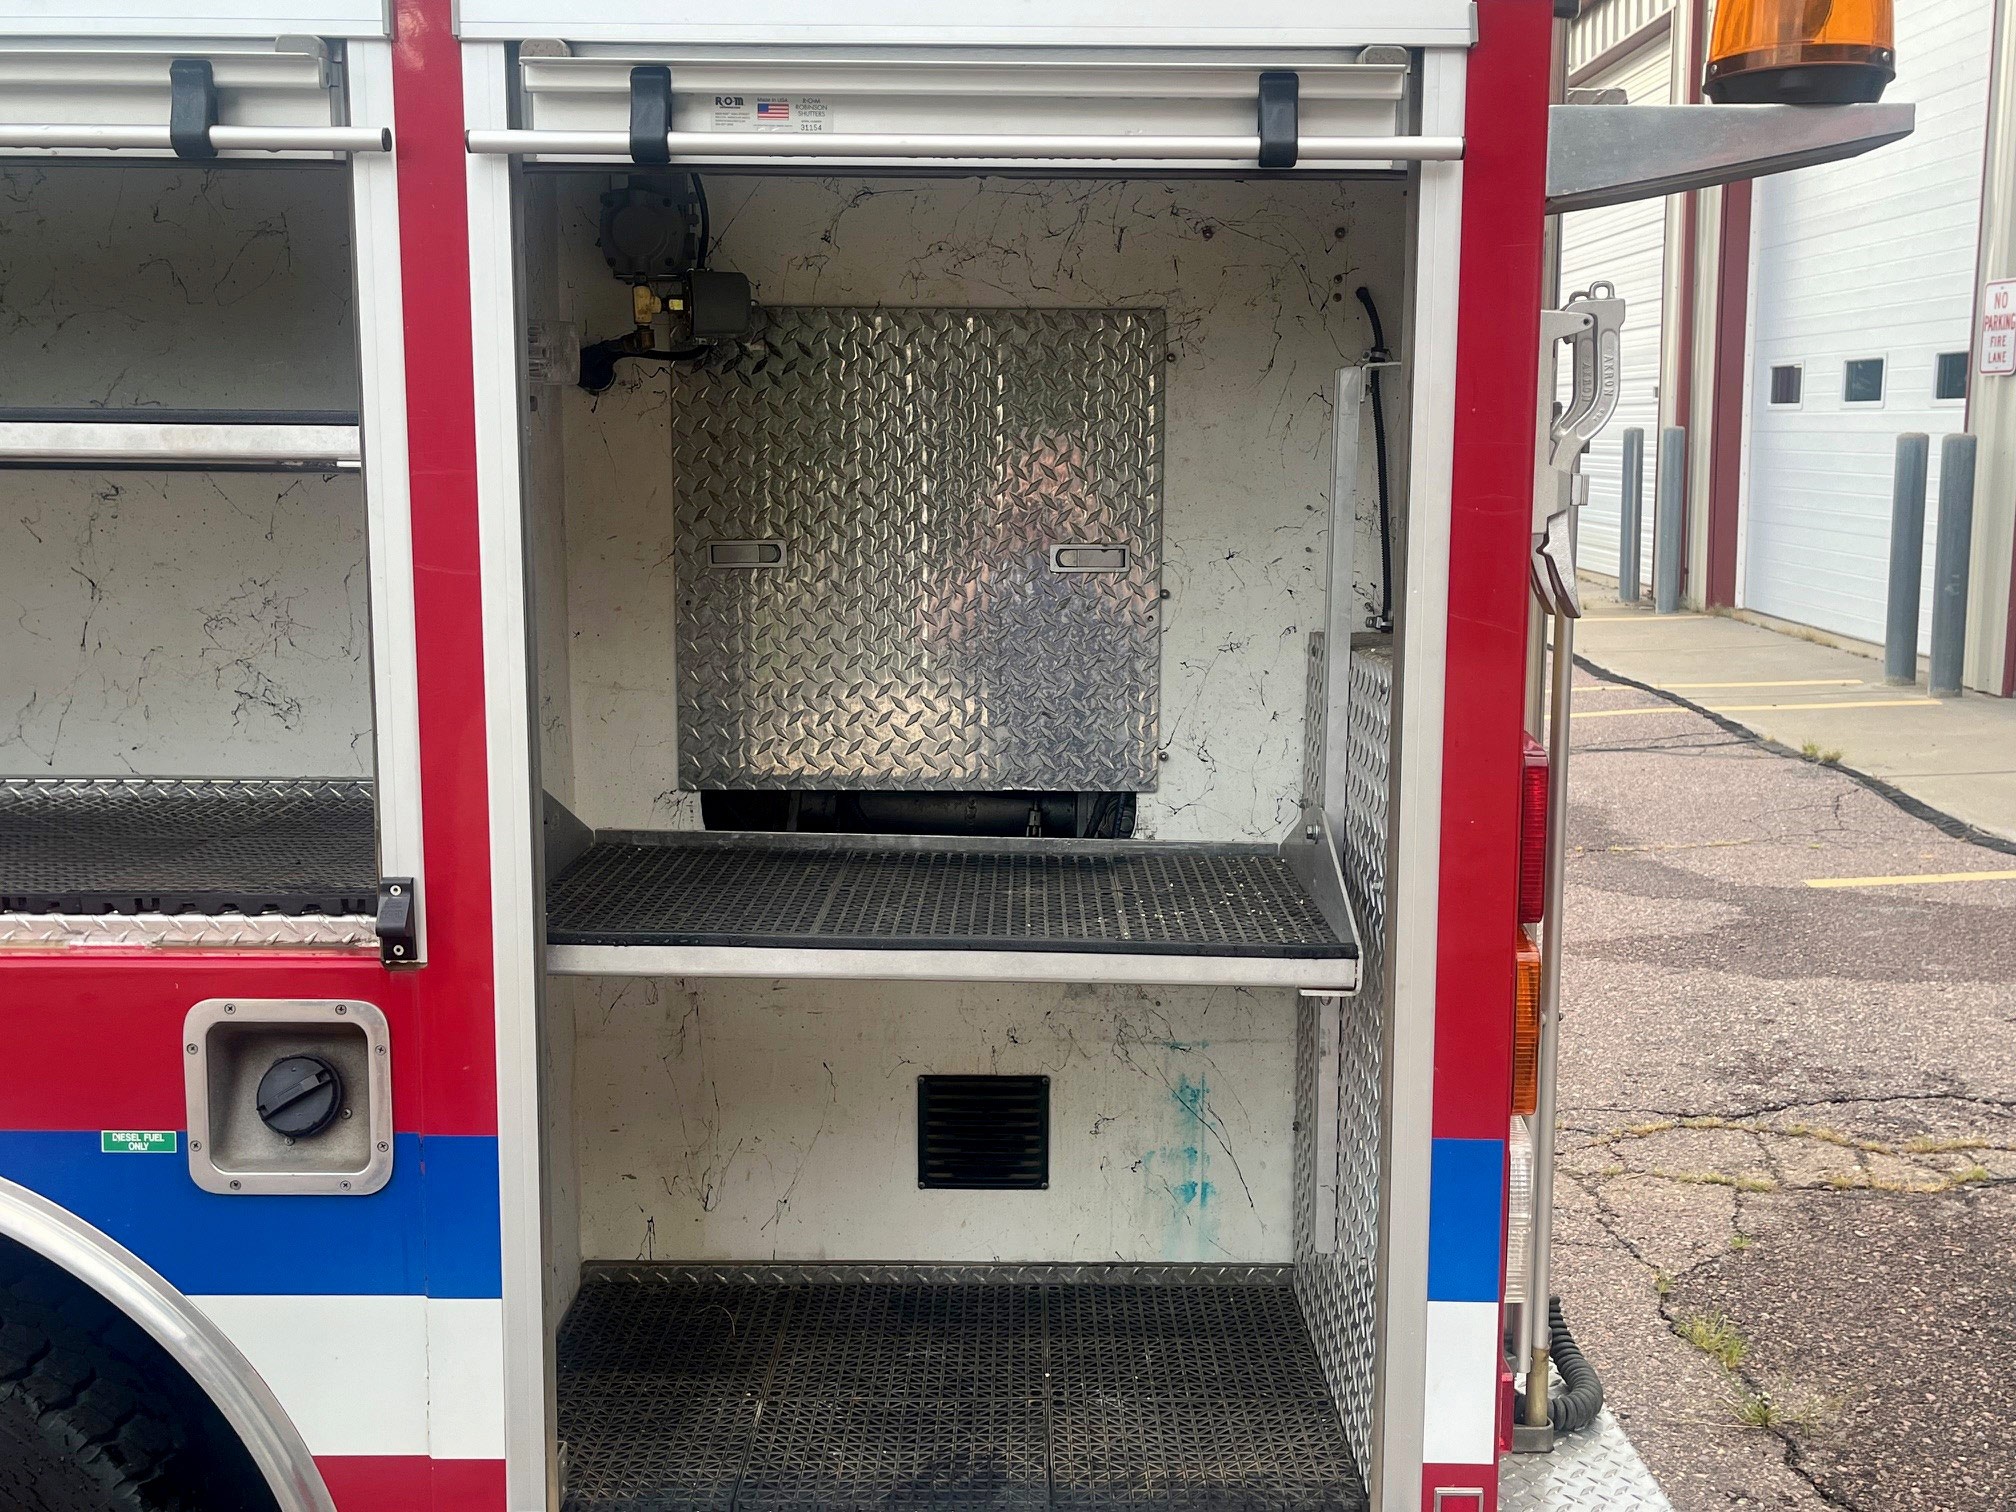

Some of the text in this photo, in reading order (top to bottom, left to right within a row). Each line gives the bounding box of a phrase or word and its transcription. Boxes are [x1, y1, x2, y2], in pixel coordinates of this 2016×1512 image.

[1994, 291, 2009, 310] NO
[1984, 312, 2016, 332] PARKING
[1990, 335, 2007, 348] FIRE
[1988, 351, 2007, 364] LANE
[1603, 354, 1615, 397] AKRON
[111, 1133, 165, 1142] DIESEL FUEL
[128, 1142, 149, 1151] ONLY
